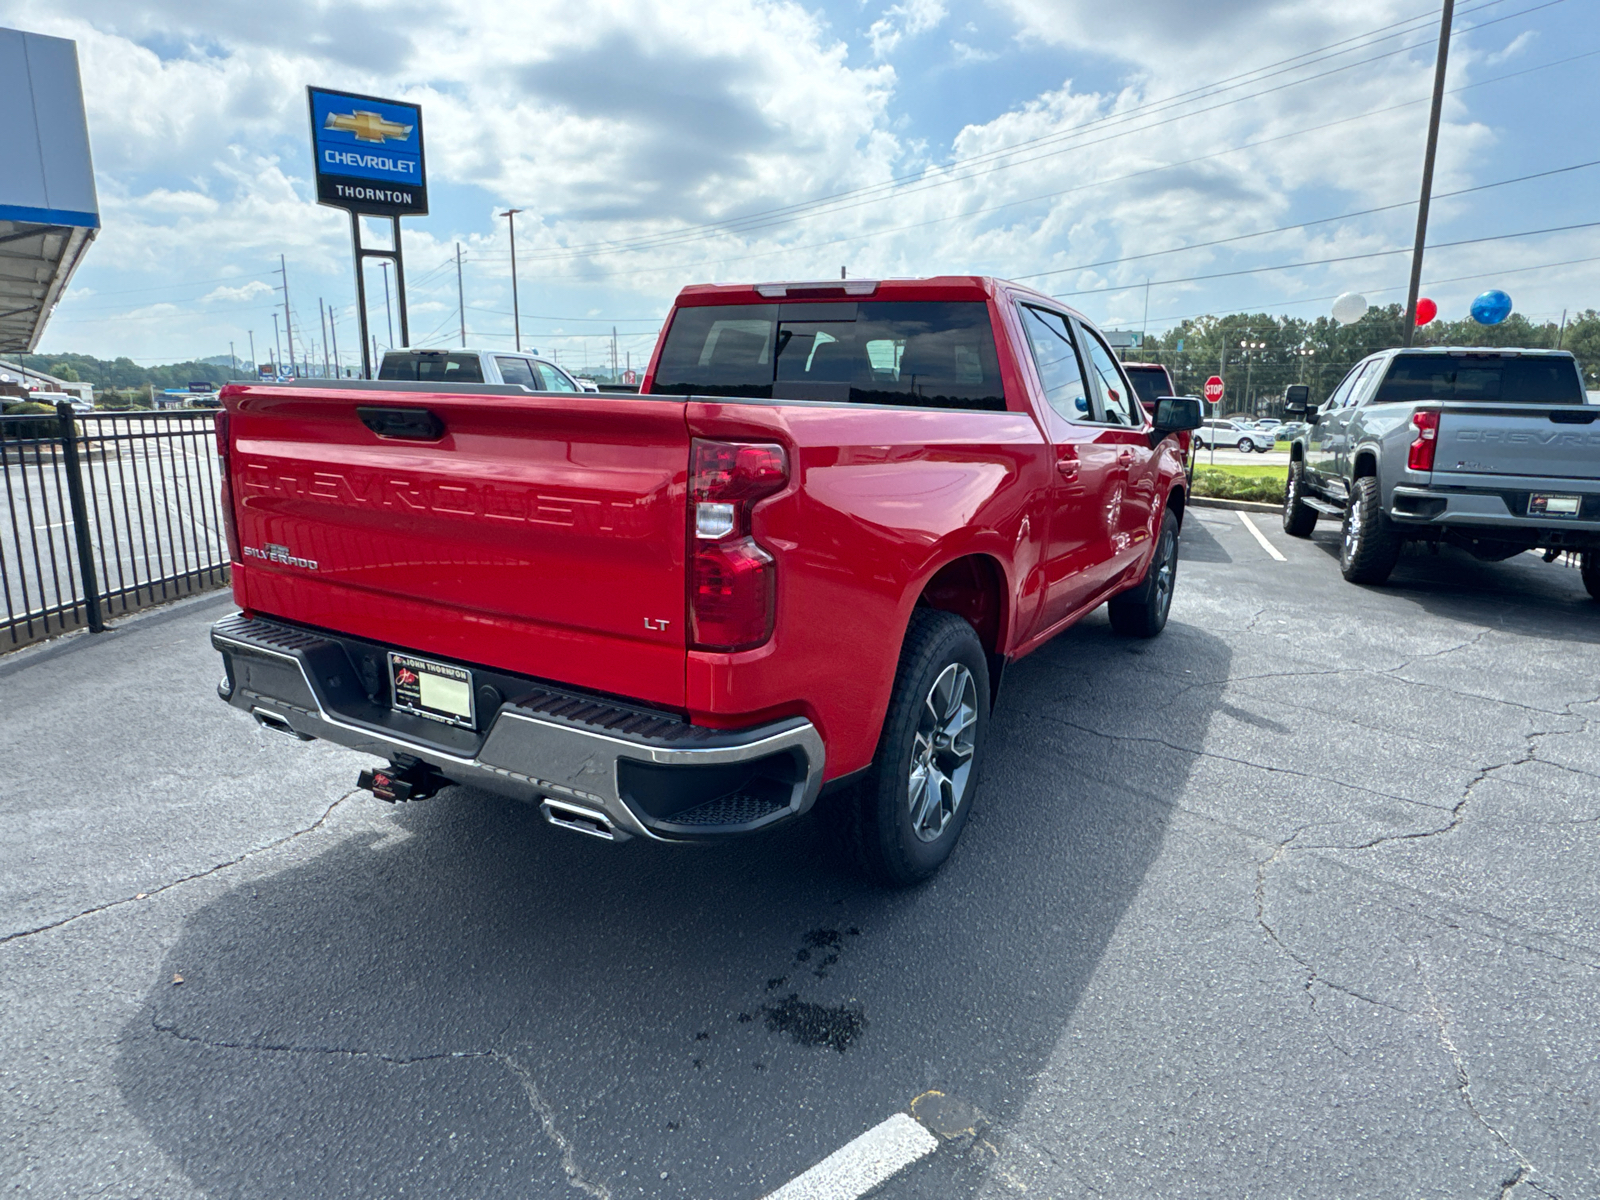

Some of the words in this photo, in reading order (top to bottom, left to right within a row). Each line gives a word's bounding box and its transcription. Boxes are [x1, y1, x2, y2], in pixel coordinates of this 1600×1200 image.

[324, 149, 416, 173] CHEVROLET
[335, 184, 412, 204] THORNTON
[1205, 384, 1222, 395] STOP
[243, 546, 318, 570] SILVERADO
[643, 617, 670, 631] LT
[405, 658, 426, 670] JOHN
[426, 663, 467, 680] THORNTON
